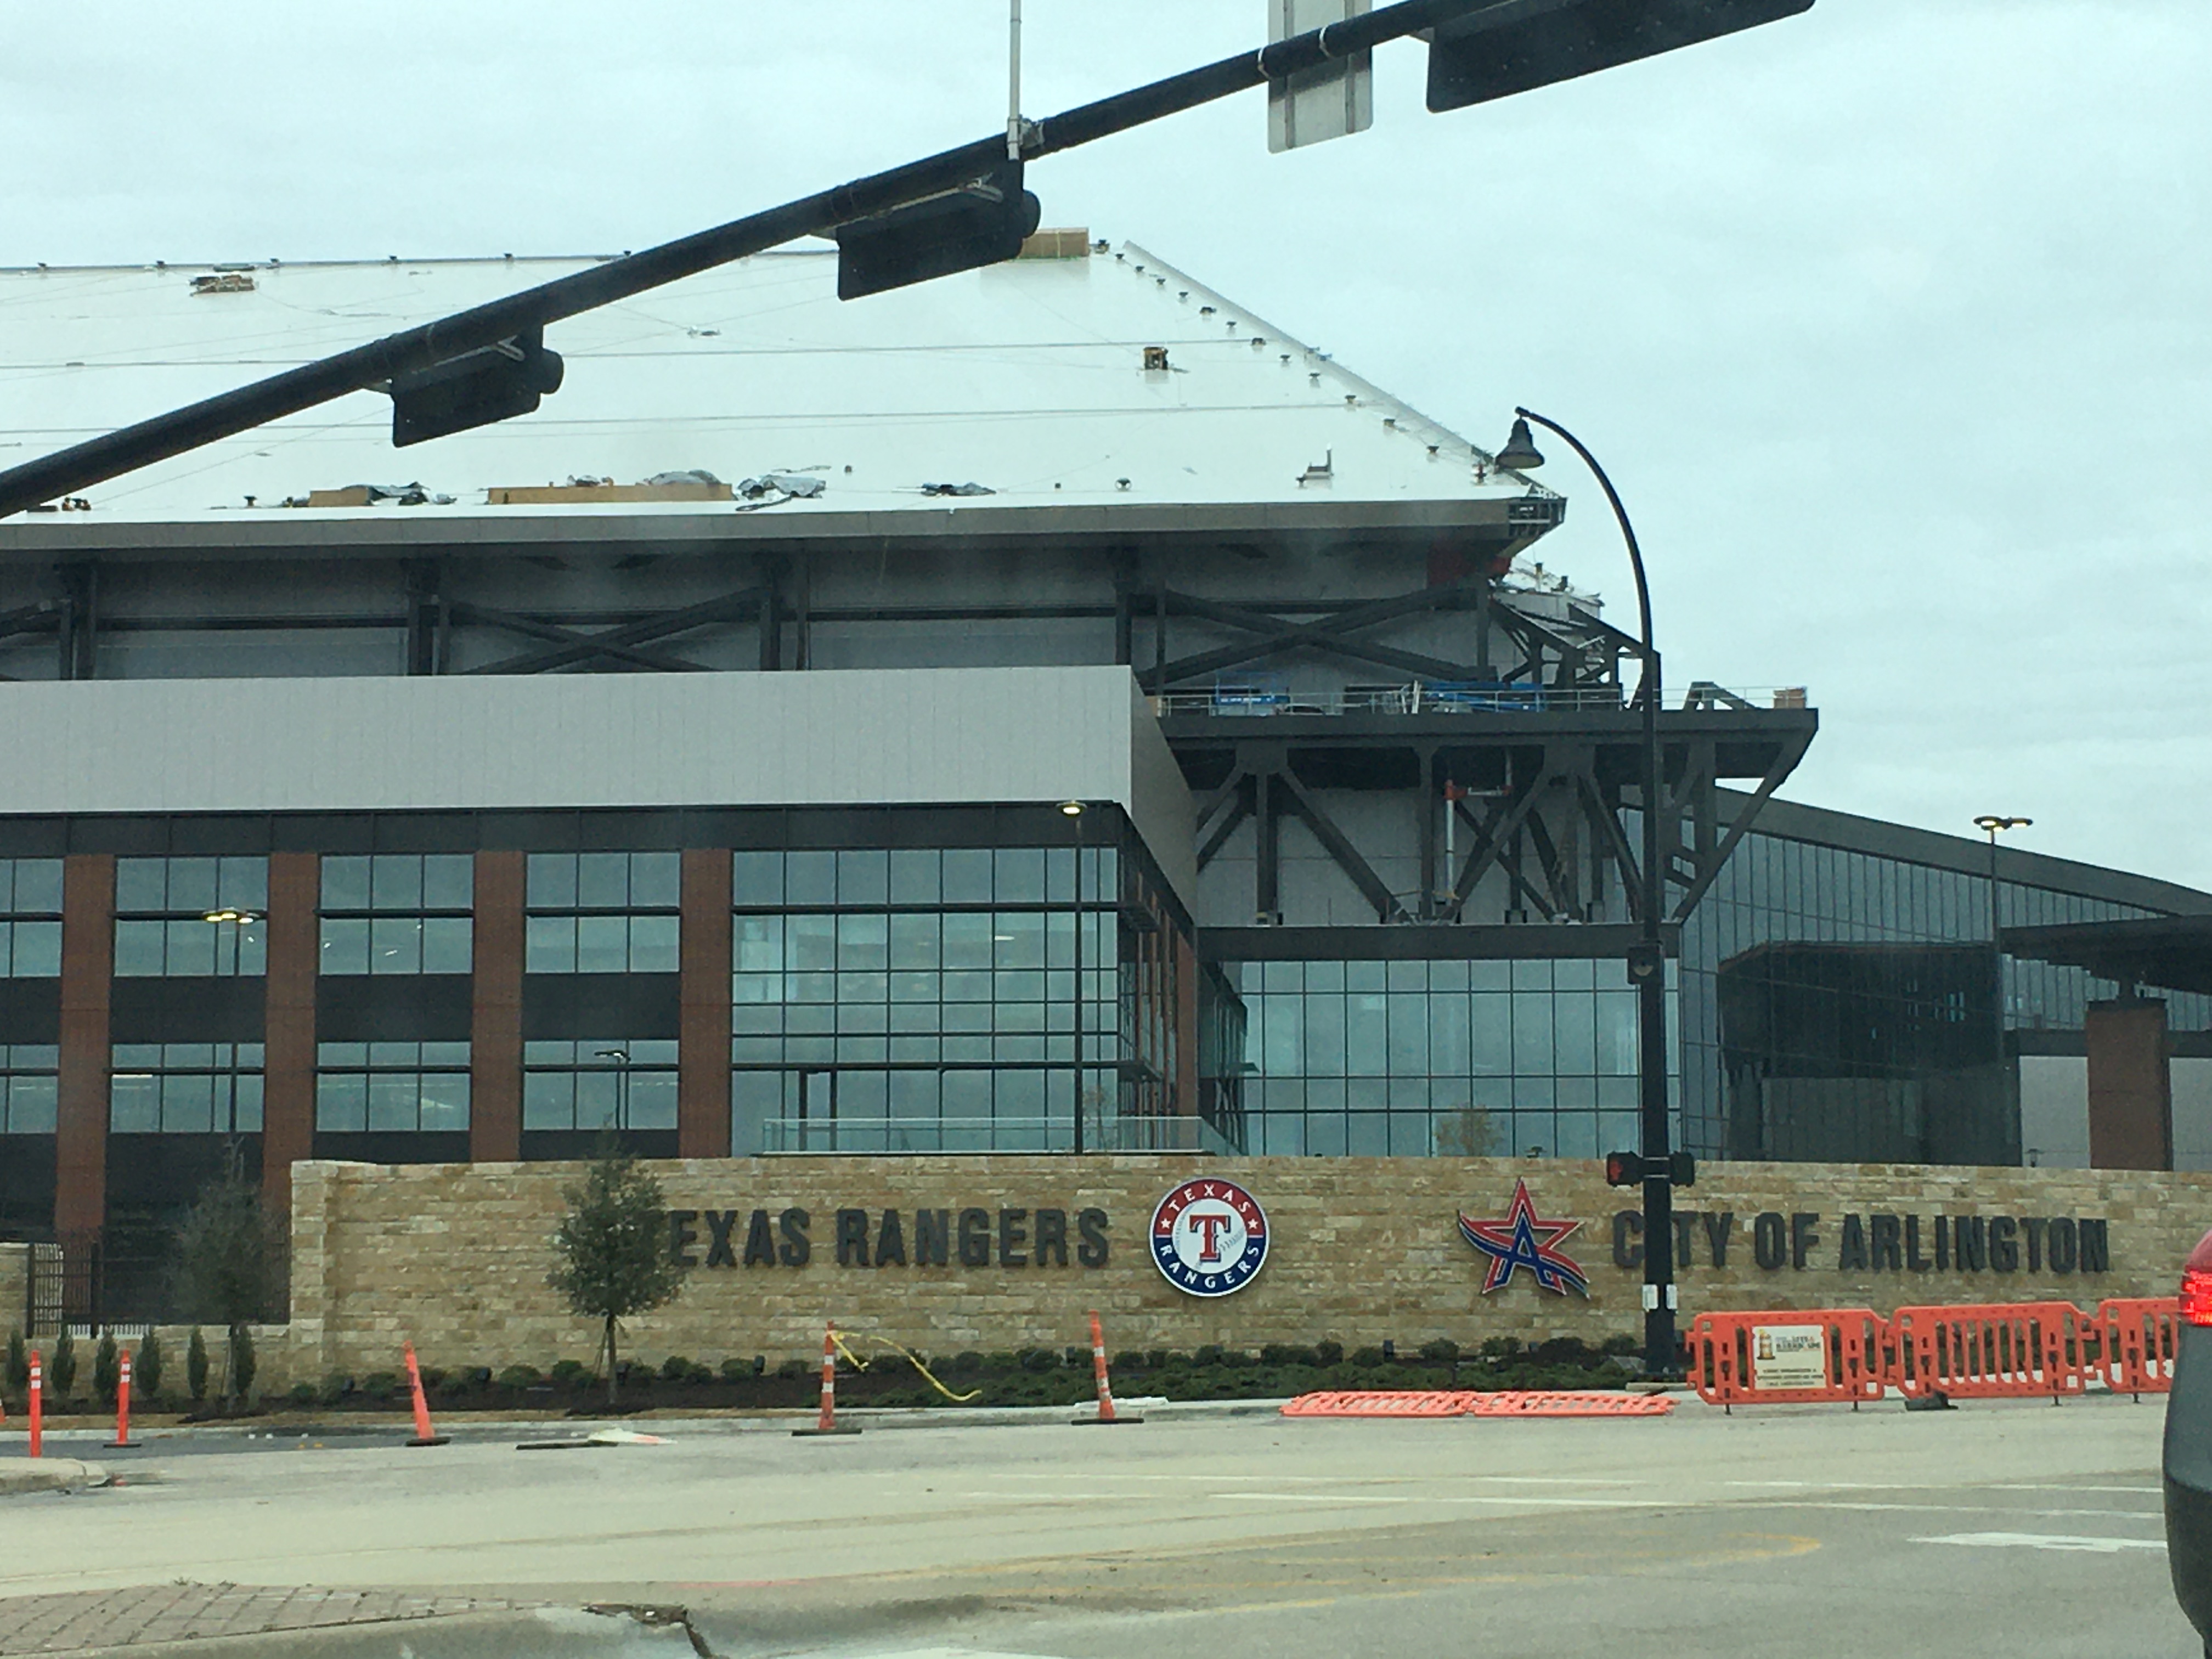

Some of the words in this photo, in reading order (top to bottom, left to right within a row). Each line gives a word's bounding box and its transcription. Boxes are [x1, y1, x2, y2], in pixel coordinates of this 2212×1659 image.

[1168, 1183, 1251, 1213] TEXAS
[836, 1207, 1109, 1268] RANGERS
[1189, 1214, 1231, 1263] T
[1613, 1209, 1734, 1271] CTY
[1755, 1211, 1820, 1271] OF
[1838, 1214, 2109, 1273] ARLINGTON
[1160, 1244, 1260, 1289] RANGERS
